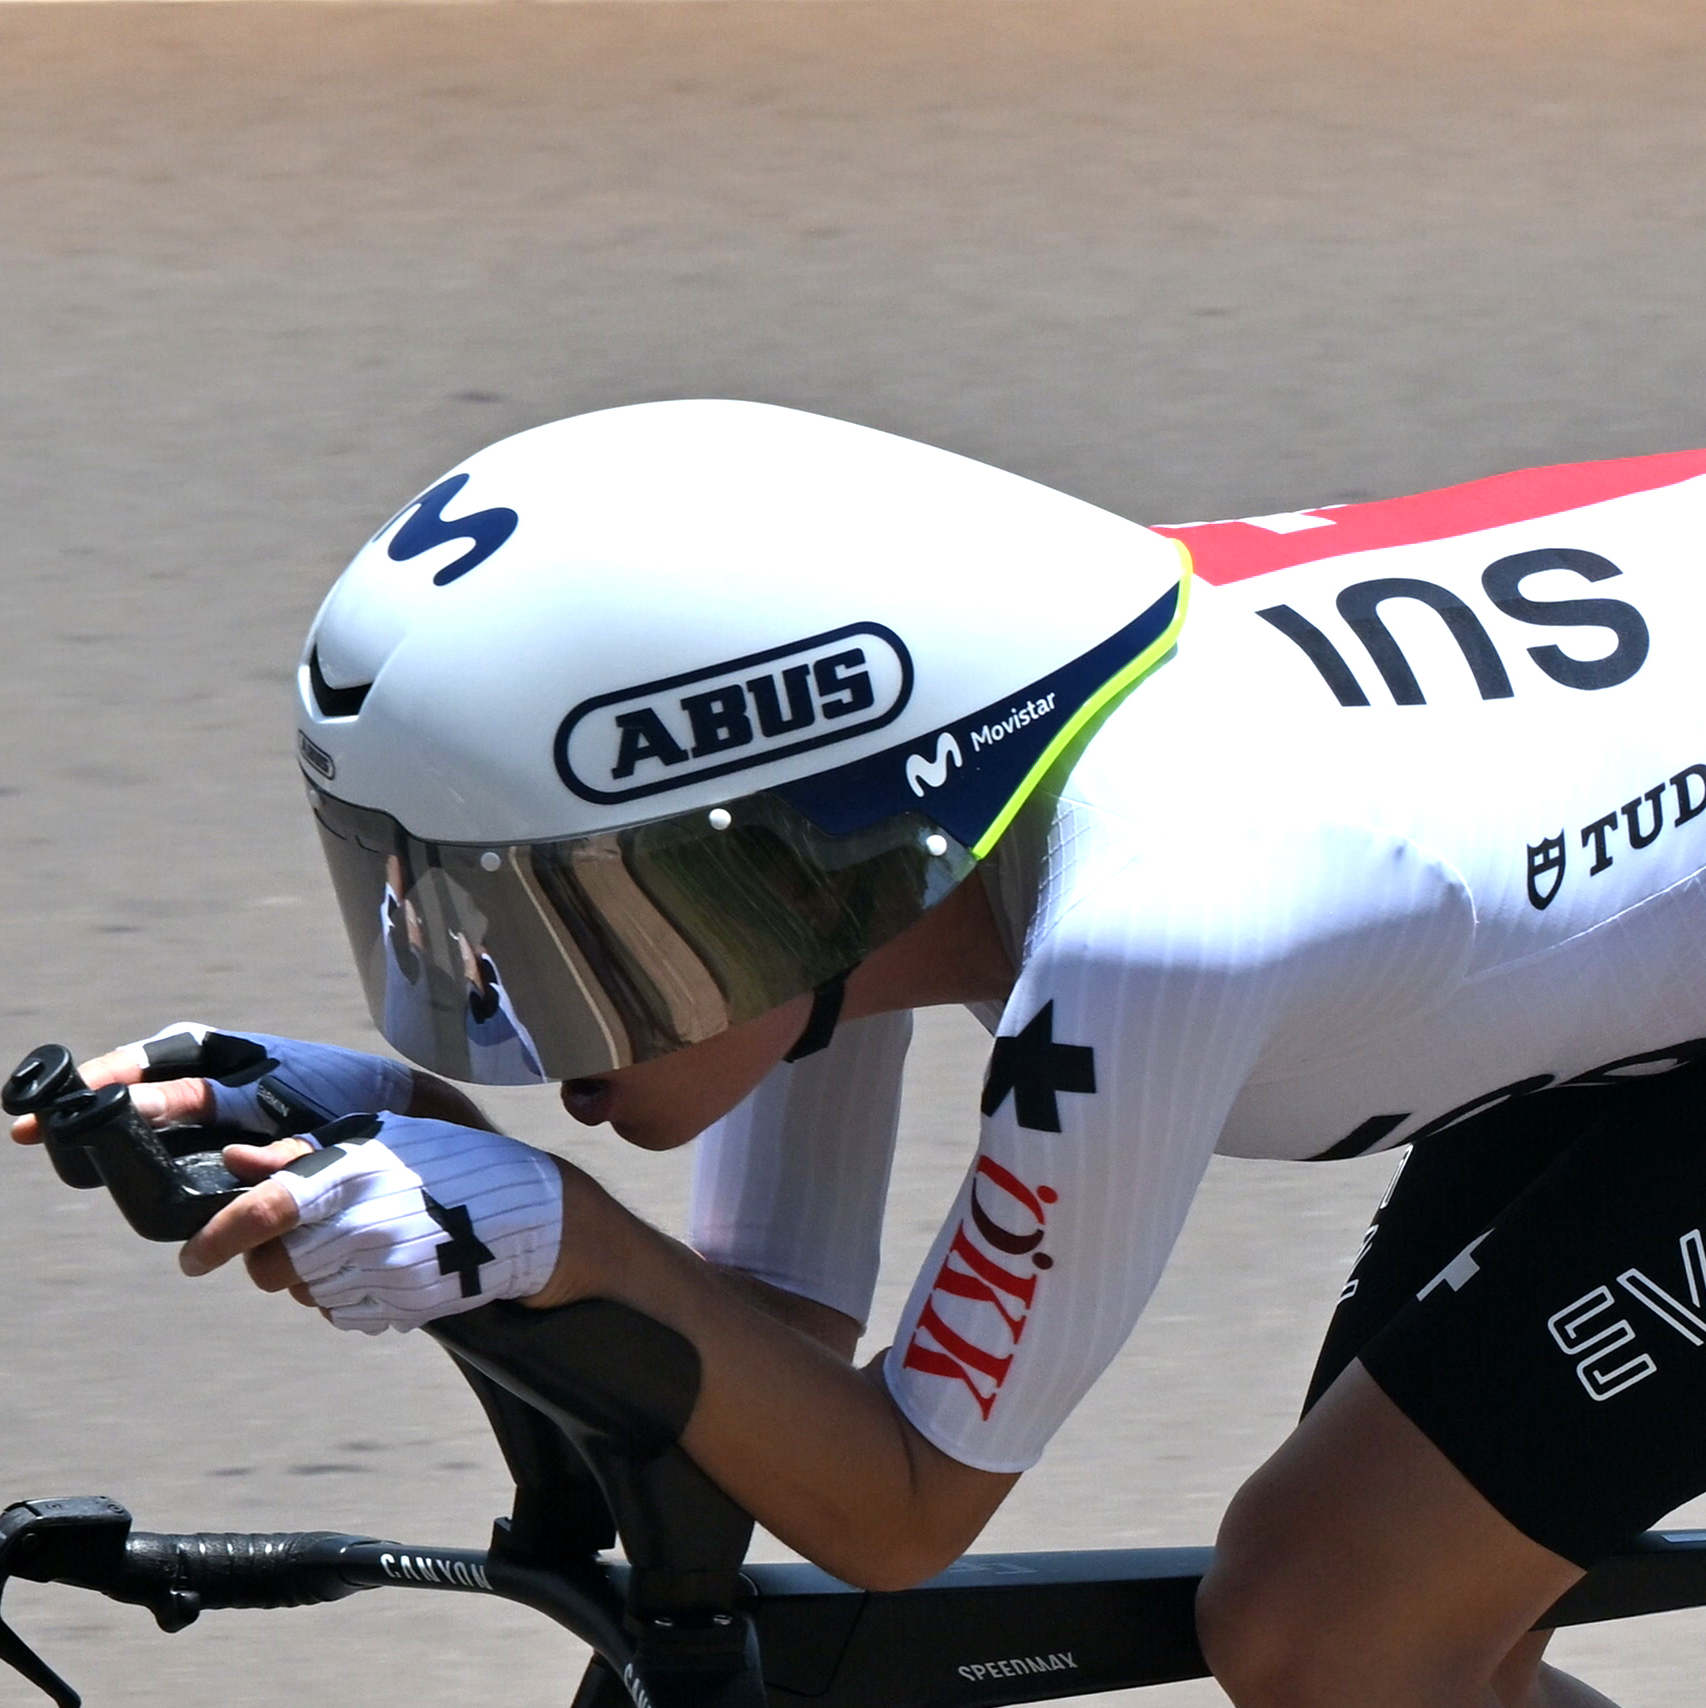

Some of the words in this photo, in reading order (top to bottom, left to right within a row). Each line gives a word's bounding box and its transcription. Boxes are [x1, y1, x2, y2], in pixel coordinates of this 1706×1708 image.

[1255, 547, 1650, 707] SUI
[610, 647, 875, 780] ABUS
[970, 690, 1057, 753] Movistar
[379, 1552, 494, 1592] CANYON
[957, 1651, 1078, 1683] SPEEDMAX
